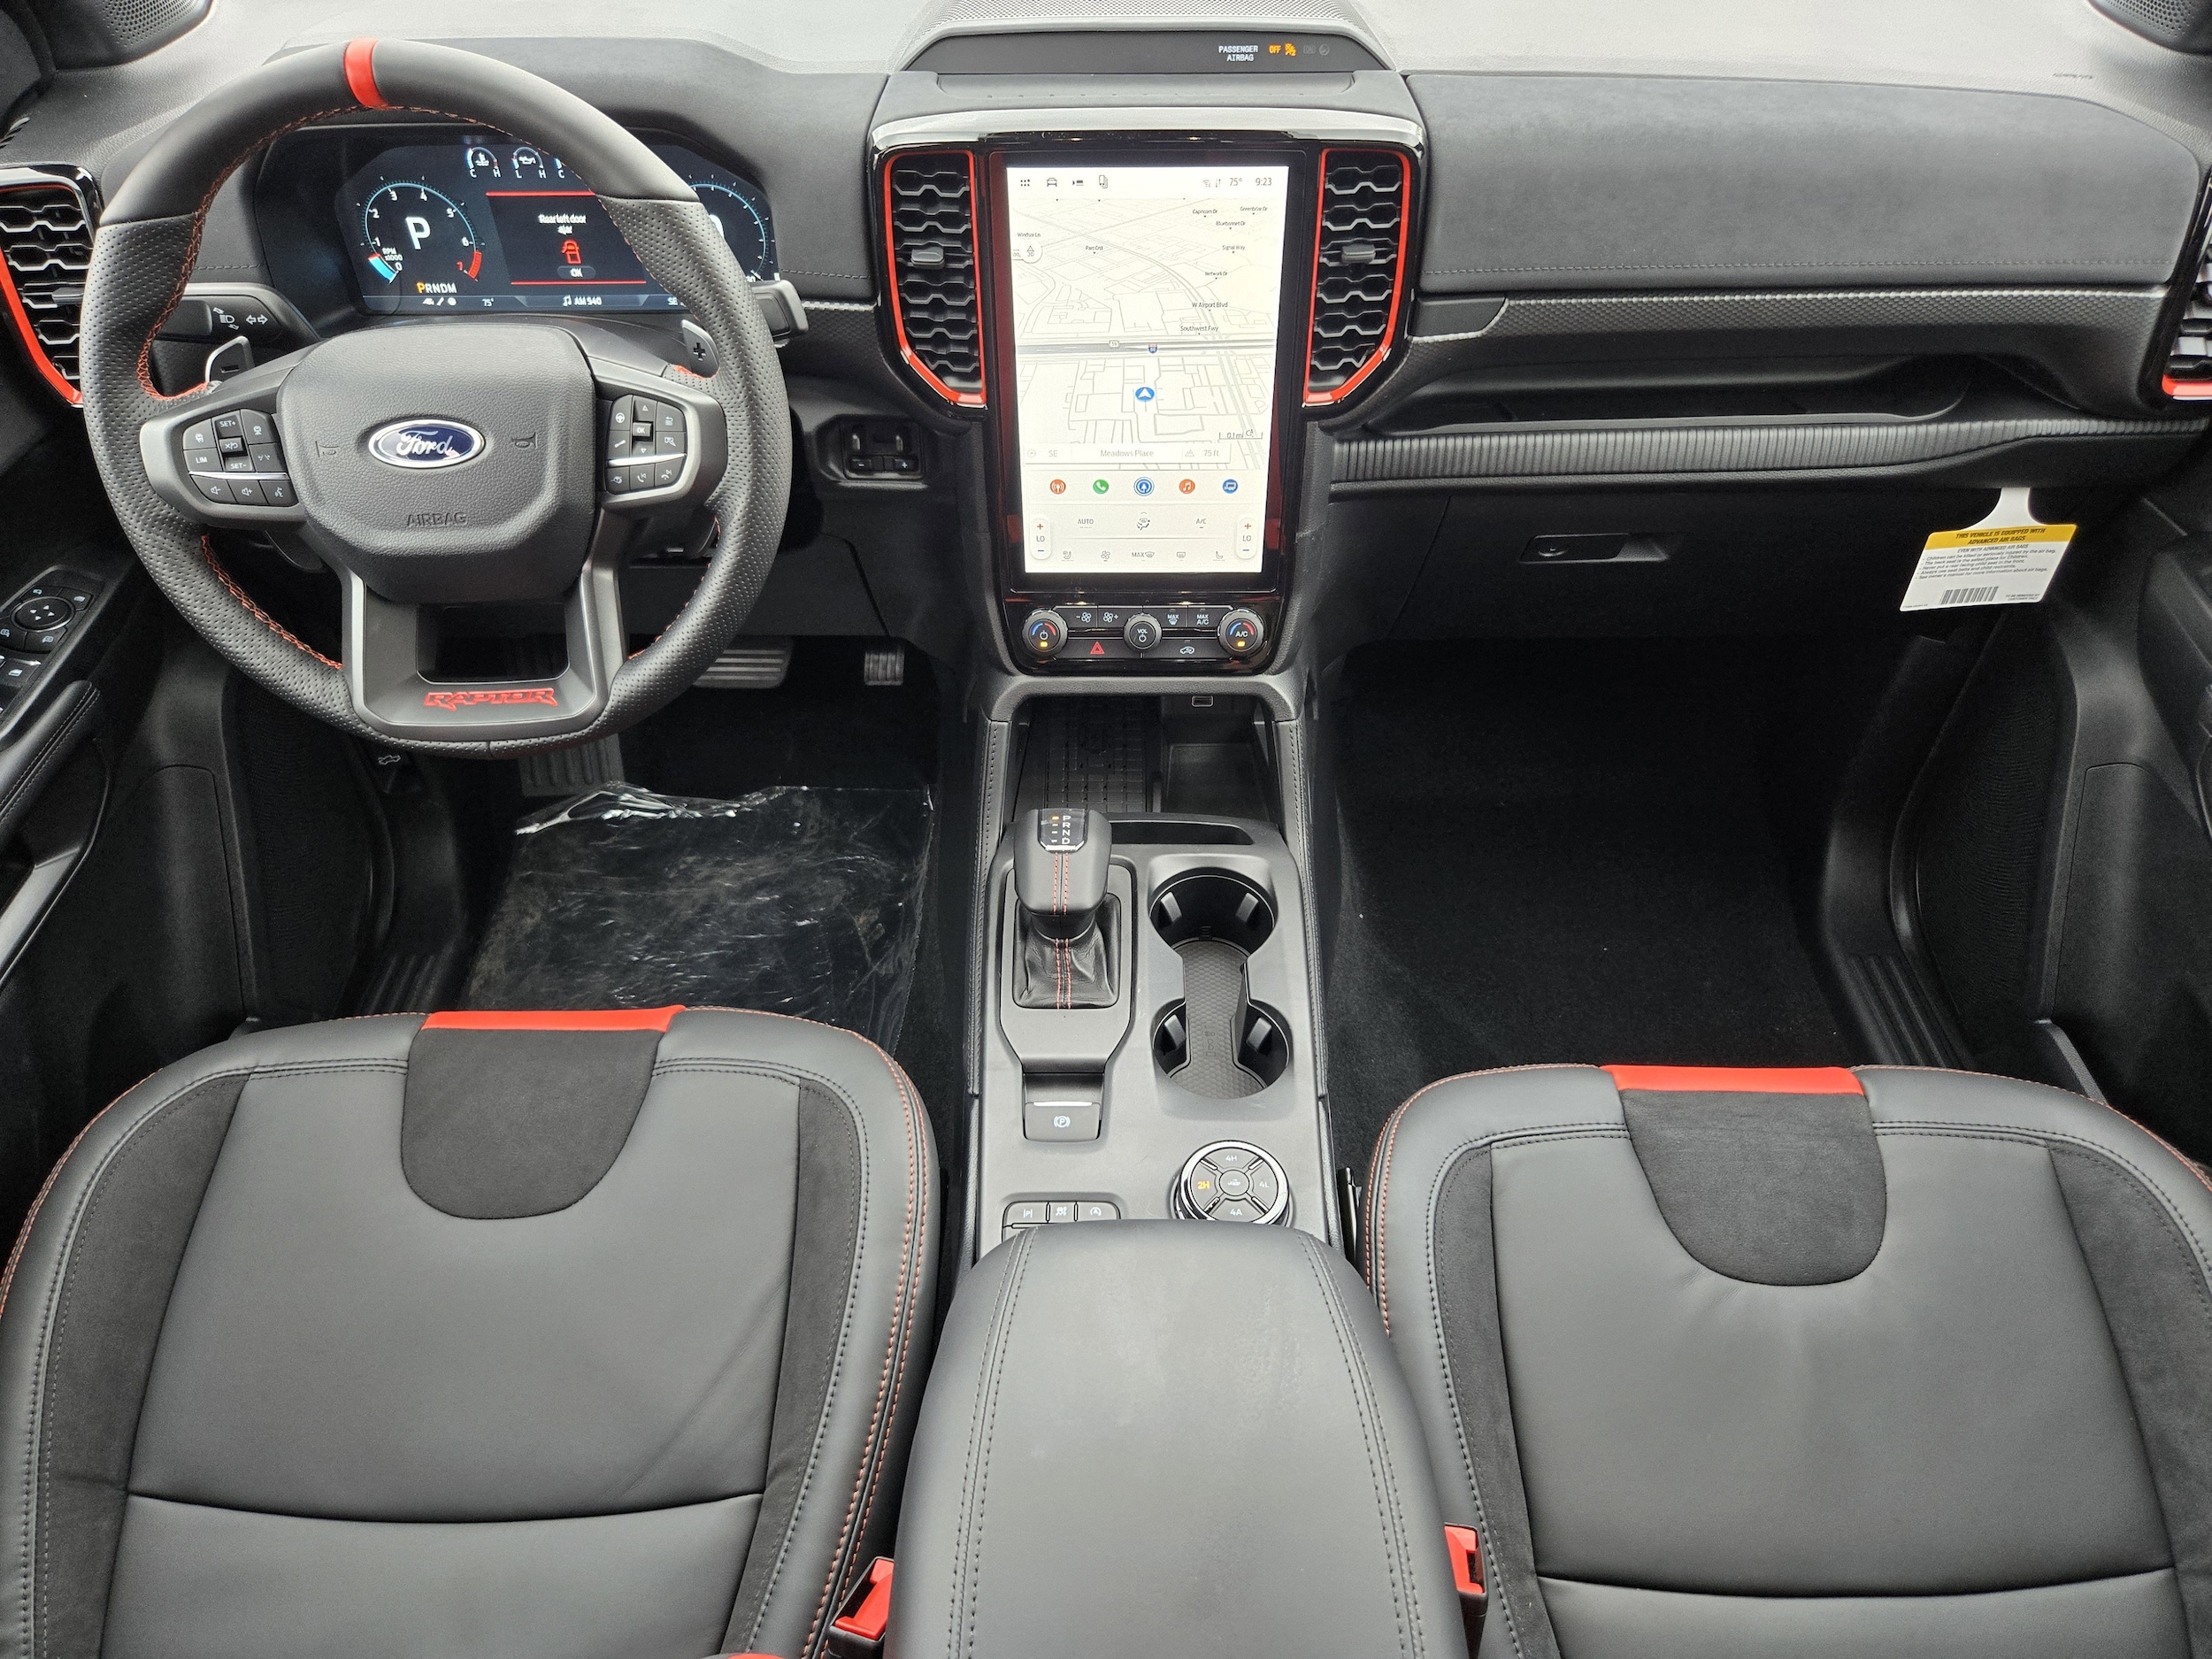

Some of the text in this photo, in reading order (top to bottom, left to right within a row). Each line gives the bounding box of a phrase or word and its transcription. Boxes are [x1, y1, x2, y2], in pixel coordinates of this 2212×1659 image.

[1269, 45, 1281, 54] OFF
[470, 169, 477, 178] C
[1255, 177, 1272, 186] 9:23
[390, 190, 398, 201] 3
[419, 191, 427, 202] 4
[372, 208, 380, 219] 2
[446, 208, 454, 218] 5
[538, 213, 587, 224] Rear left door
[405, 216, 431, 250] P
[557, 225, 573, 235] ajar
[374, 236, 380, 247] 1
[462, 236, 469, 247] 6
[395, 262, 403, 271] 0
[570, 268, 583, 278] OK
[574, 296, 587, 306] AM
[668, 297, 679, 306] SE
[396, 429, 454, 457] Ford
[406, 511, 468, 526] AIRBAG
[424, 687, 558, 711] RAPTOR
